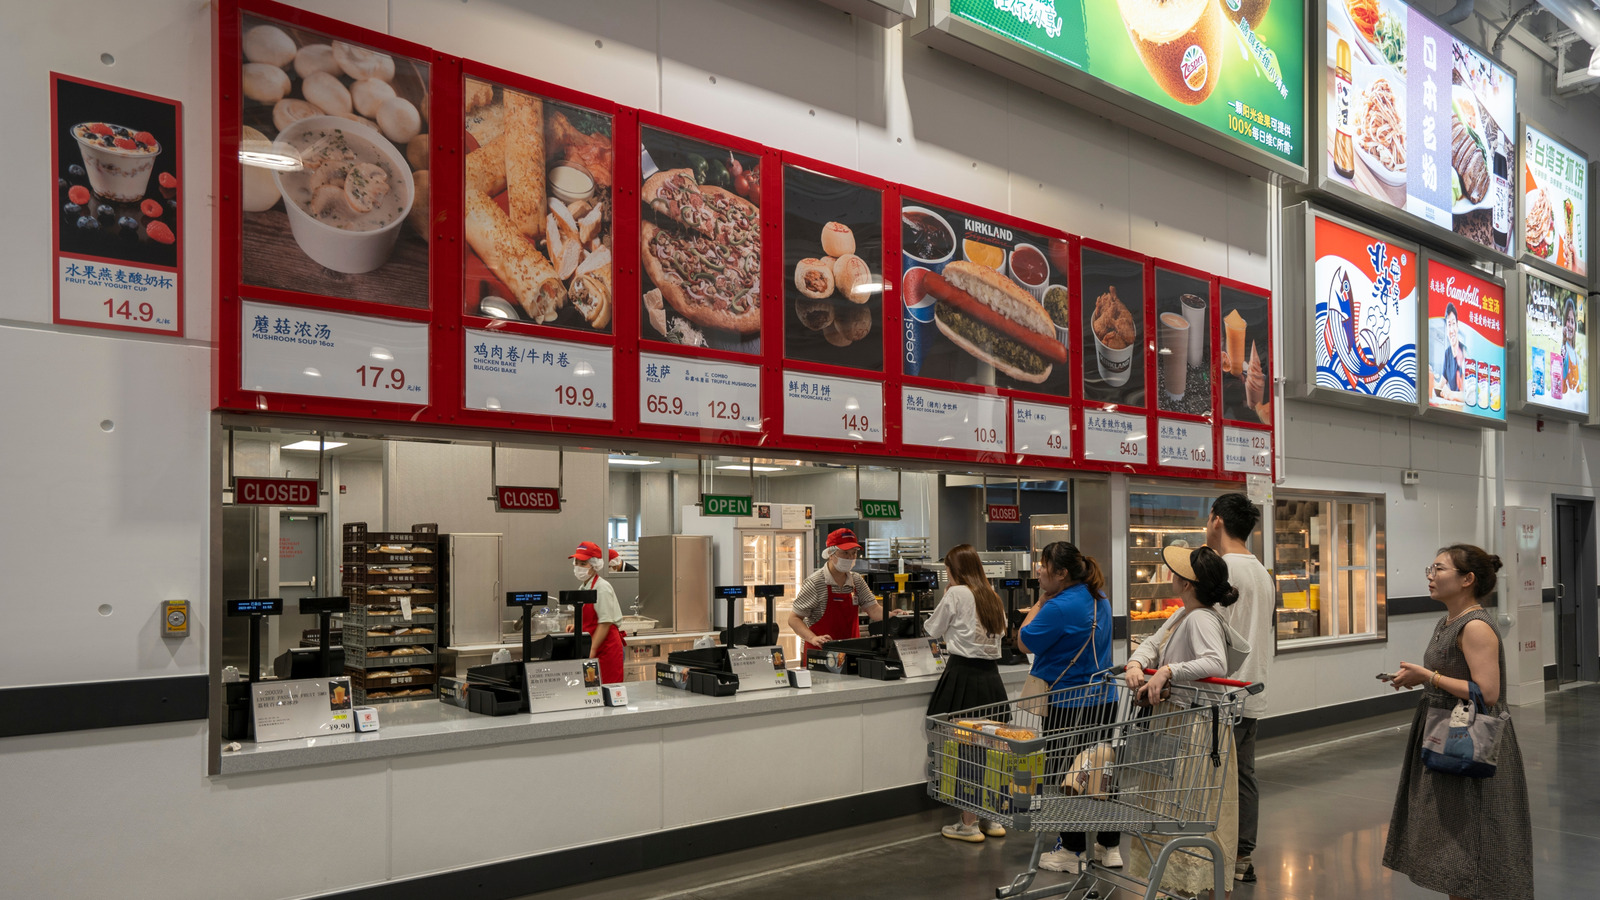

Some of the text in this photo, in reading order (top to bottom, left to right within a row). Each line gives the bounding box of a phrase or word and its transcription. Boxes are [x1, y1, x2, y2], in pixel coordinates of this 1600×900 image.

[1182, 53, 1204, 80] Zespri
[1228, 100, 1291, 138] 一颗阳光金果可提供
[1422, 35, 1437, 192] 日本名物
[1535, 139, 1584, 188] 台湾手抓饼
[965, 218, 1013, 241] KIRKLAND
[65, 264, 173, 289] 水果燕麦酸奶杯
[104, 282, 132, 290] YOGURT
[104, 298, 154, 322] 14.9
[1482, 295, 1500, 314] 金宝汤
[252, 315, 331, 340] 蘑菇浓汤
[252, 333, 296, 344] MUSHROOM
[904, 318, 916, 364] pepsi
[474, 342, 570, 368] 鸡肉卷/牛肉卷
[474, 358, 500, 366] CHICKEN
[356, 365, 405, 390] 17.9
[474, 364, 500, 373] BULGOGI
[646, 364, 670, 378] 披萨
[555, 385, 594, 406] 19.9
[789, 380, 830, 396] 鲜肉月饼
[647, 395, 682, 414] 65.9
[708, 400, 740, 420] 12.9
[842, 414, 868, 432] 14.9
[974, 428, 996, 444] 10.9
[1047, 435, 1062, 449] 4.9
[1252, 437, 1265, 448] 12.9
[1120, 442, 1138, 456] 54.9
[1191, 449, 1206, 462] 10.9
[1252, 456, 1265, 467] 14.9
[244, 484, 310, 502] CLOSED
[504, 492, 554, 506] CLOSED
[708, 499, 748, 513] OPEN
[866, 504, 897, 516] OPEN
[991, 508, 1017, 519] CLOSED
